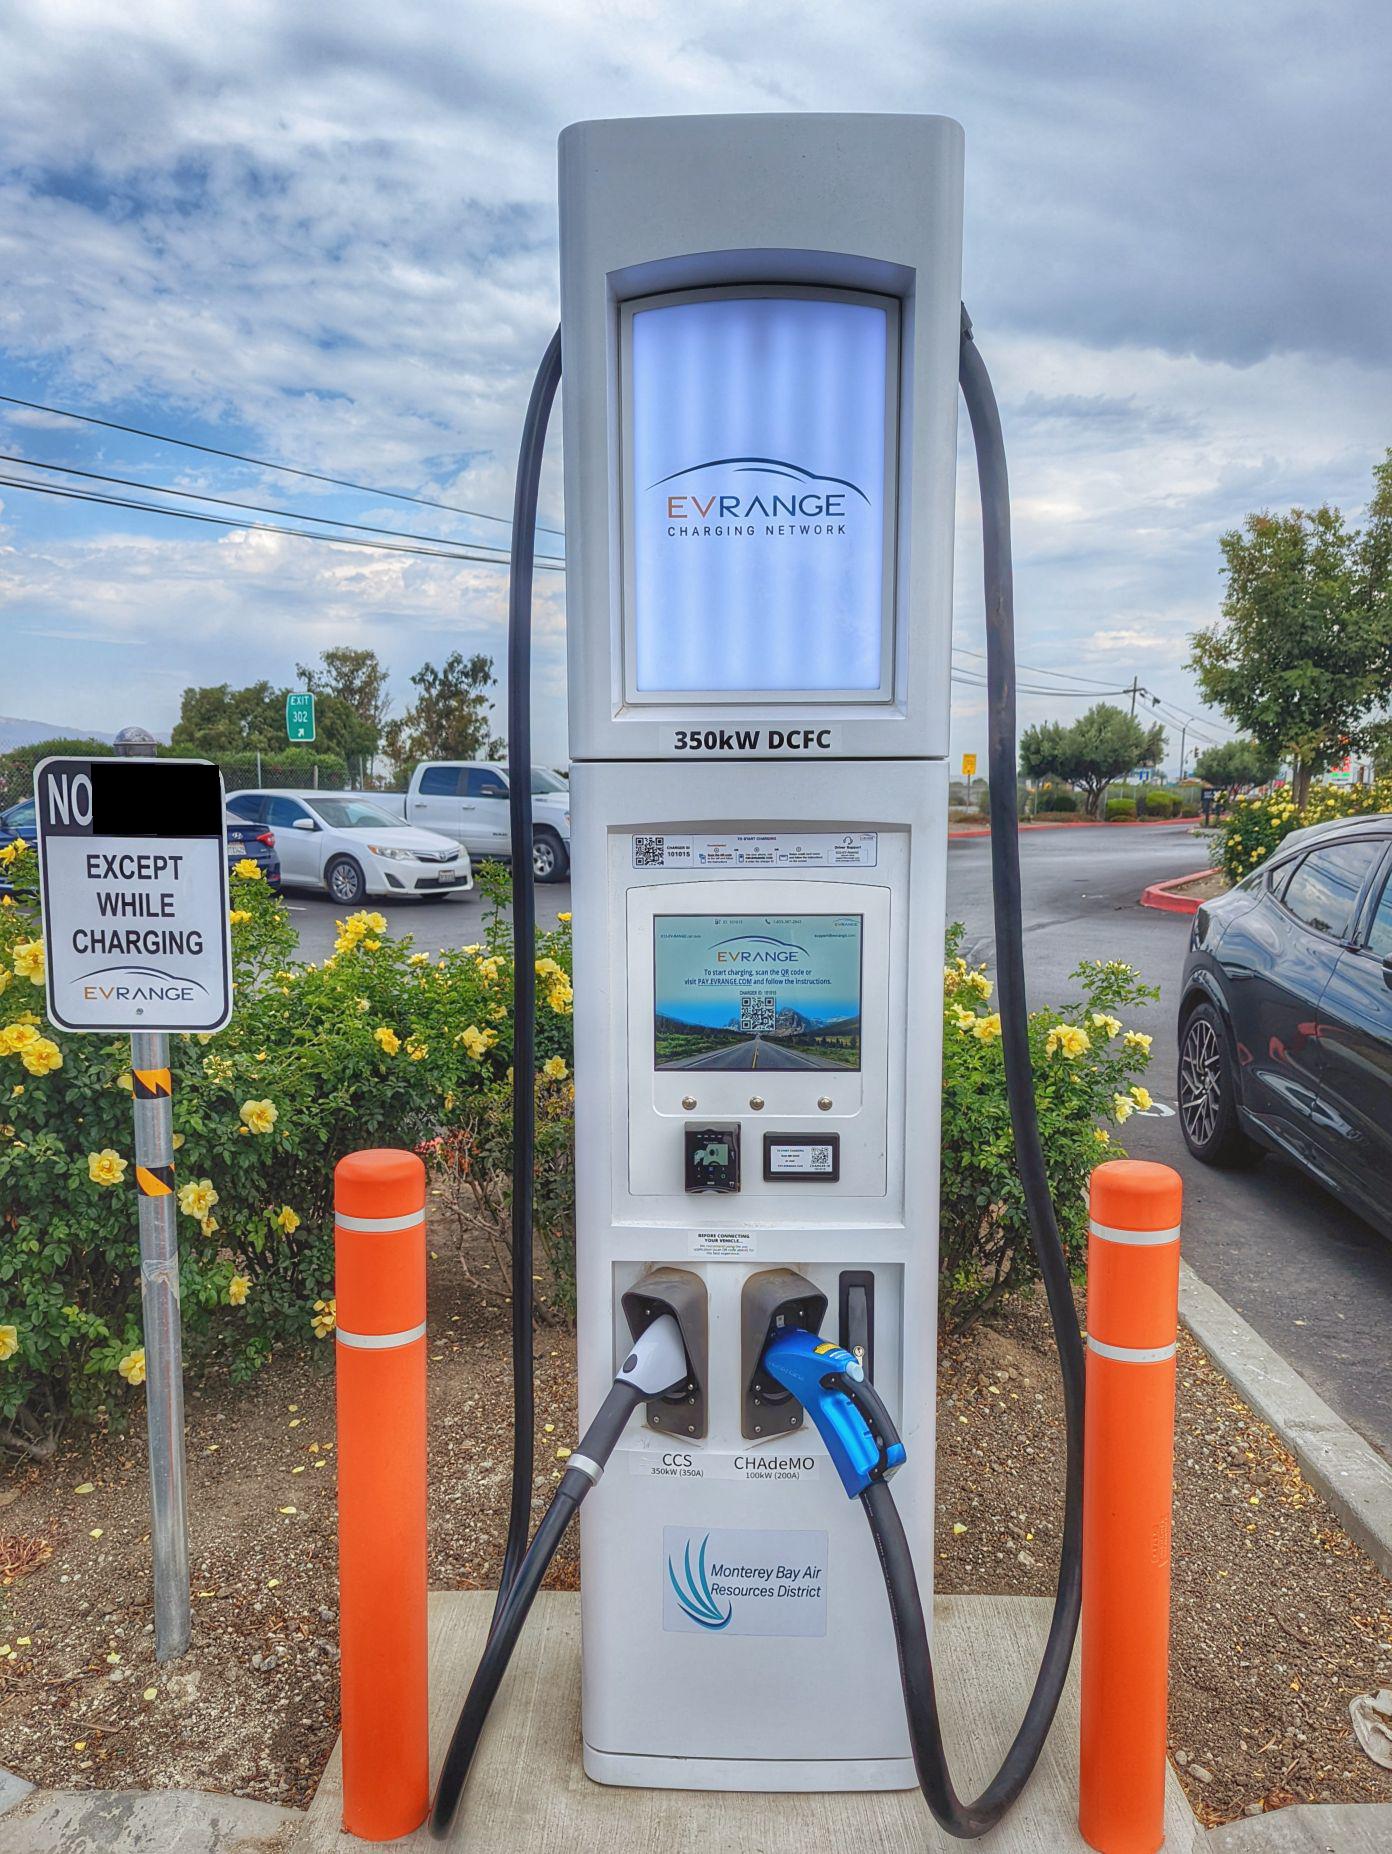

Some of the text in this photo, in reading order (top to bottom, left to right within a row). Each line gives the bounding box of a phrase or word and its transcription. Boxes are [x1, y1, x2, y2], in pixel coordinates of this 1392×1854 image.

[667, 494, 845, 519] EVRANGE
[667, 524, 846, 537] CHARGING NETWORK
[290, 695, 310, 705] EXIT
[292, 711, 308, 723] 302
[673, 729, 831, 750] 350kW DCFC
[47, 773, 93, 826] NO
[86, 854, 183, 880] EXCEPT
[96, 892, 175, 918] WHILE
[72, 929, 204, 955] CHARGING
[717, 951, 799, 962] EVRANGE
[781, 969, 789, 977] QR
[84, 986, 194, 1001] EVRANGE
[662, 1453, 693, 1467] CCS
[734, 1456, 815, 1470] CHAdeMO
[650, 1467, 704, 1478] 350kW (350A)
[774, 1472, 800, 1480] (200A)
[711, 1563, 822, 1582] Monterey Bay Air
[710, 1582, 822, 1598] Resources District
